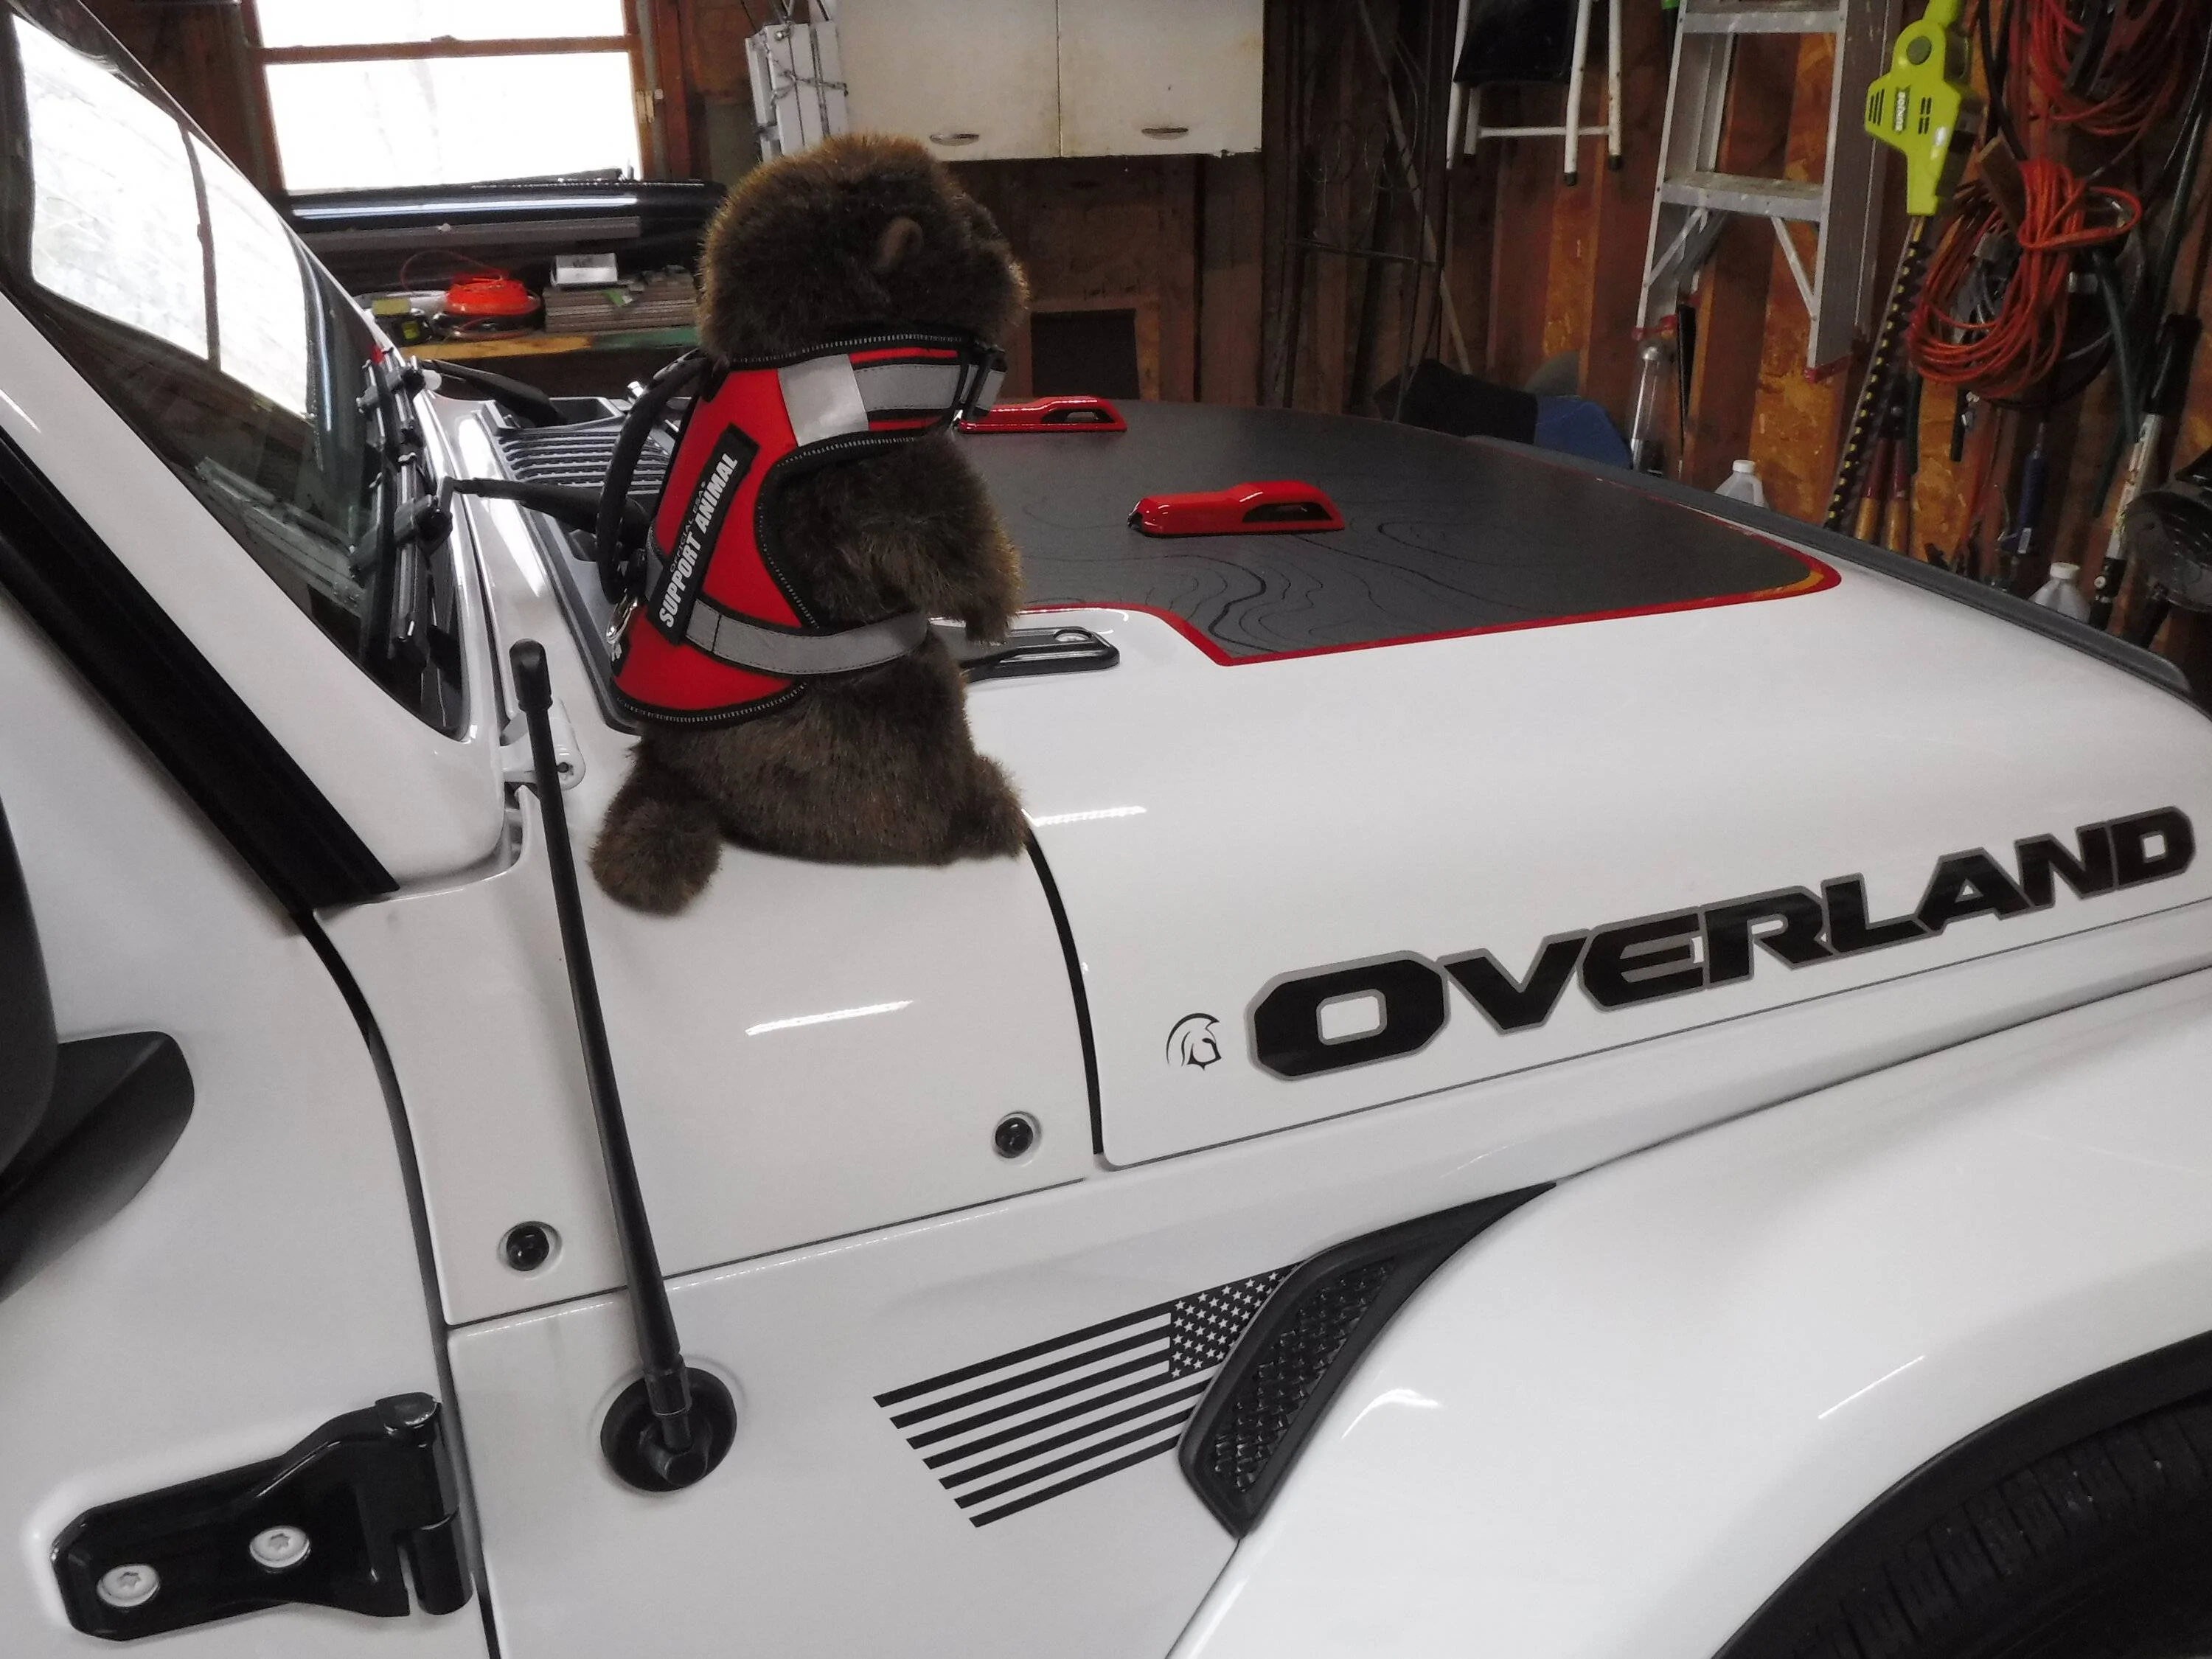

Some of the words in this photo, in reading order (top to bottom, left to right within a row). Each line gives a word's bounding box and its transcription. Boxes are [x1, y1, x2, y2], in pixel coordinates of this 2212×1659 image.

[659, 531, 701, 629] SUPPORT
[695, 453, 738, 535] ANIMAL
[669, 517, 695, 574] OFFICIAL
[1246, 806, 2195, 1081] OVERLAND
